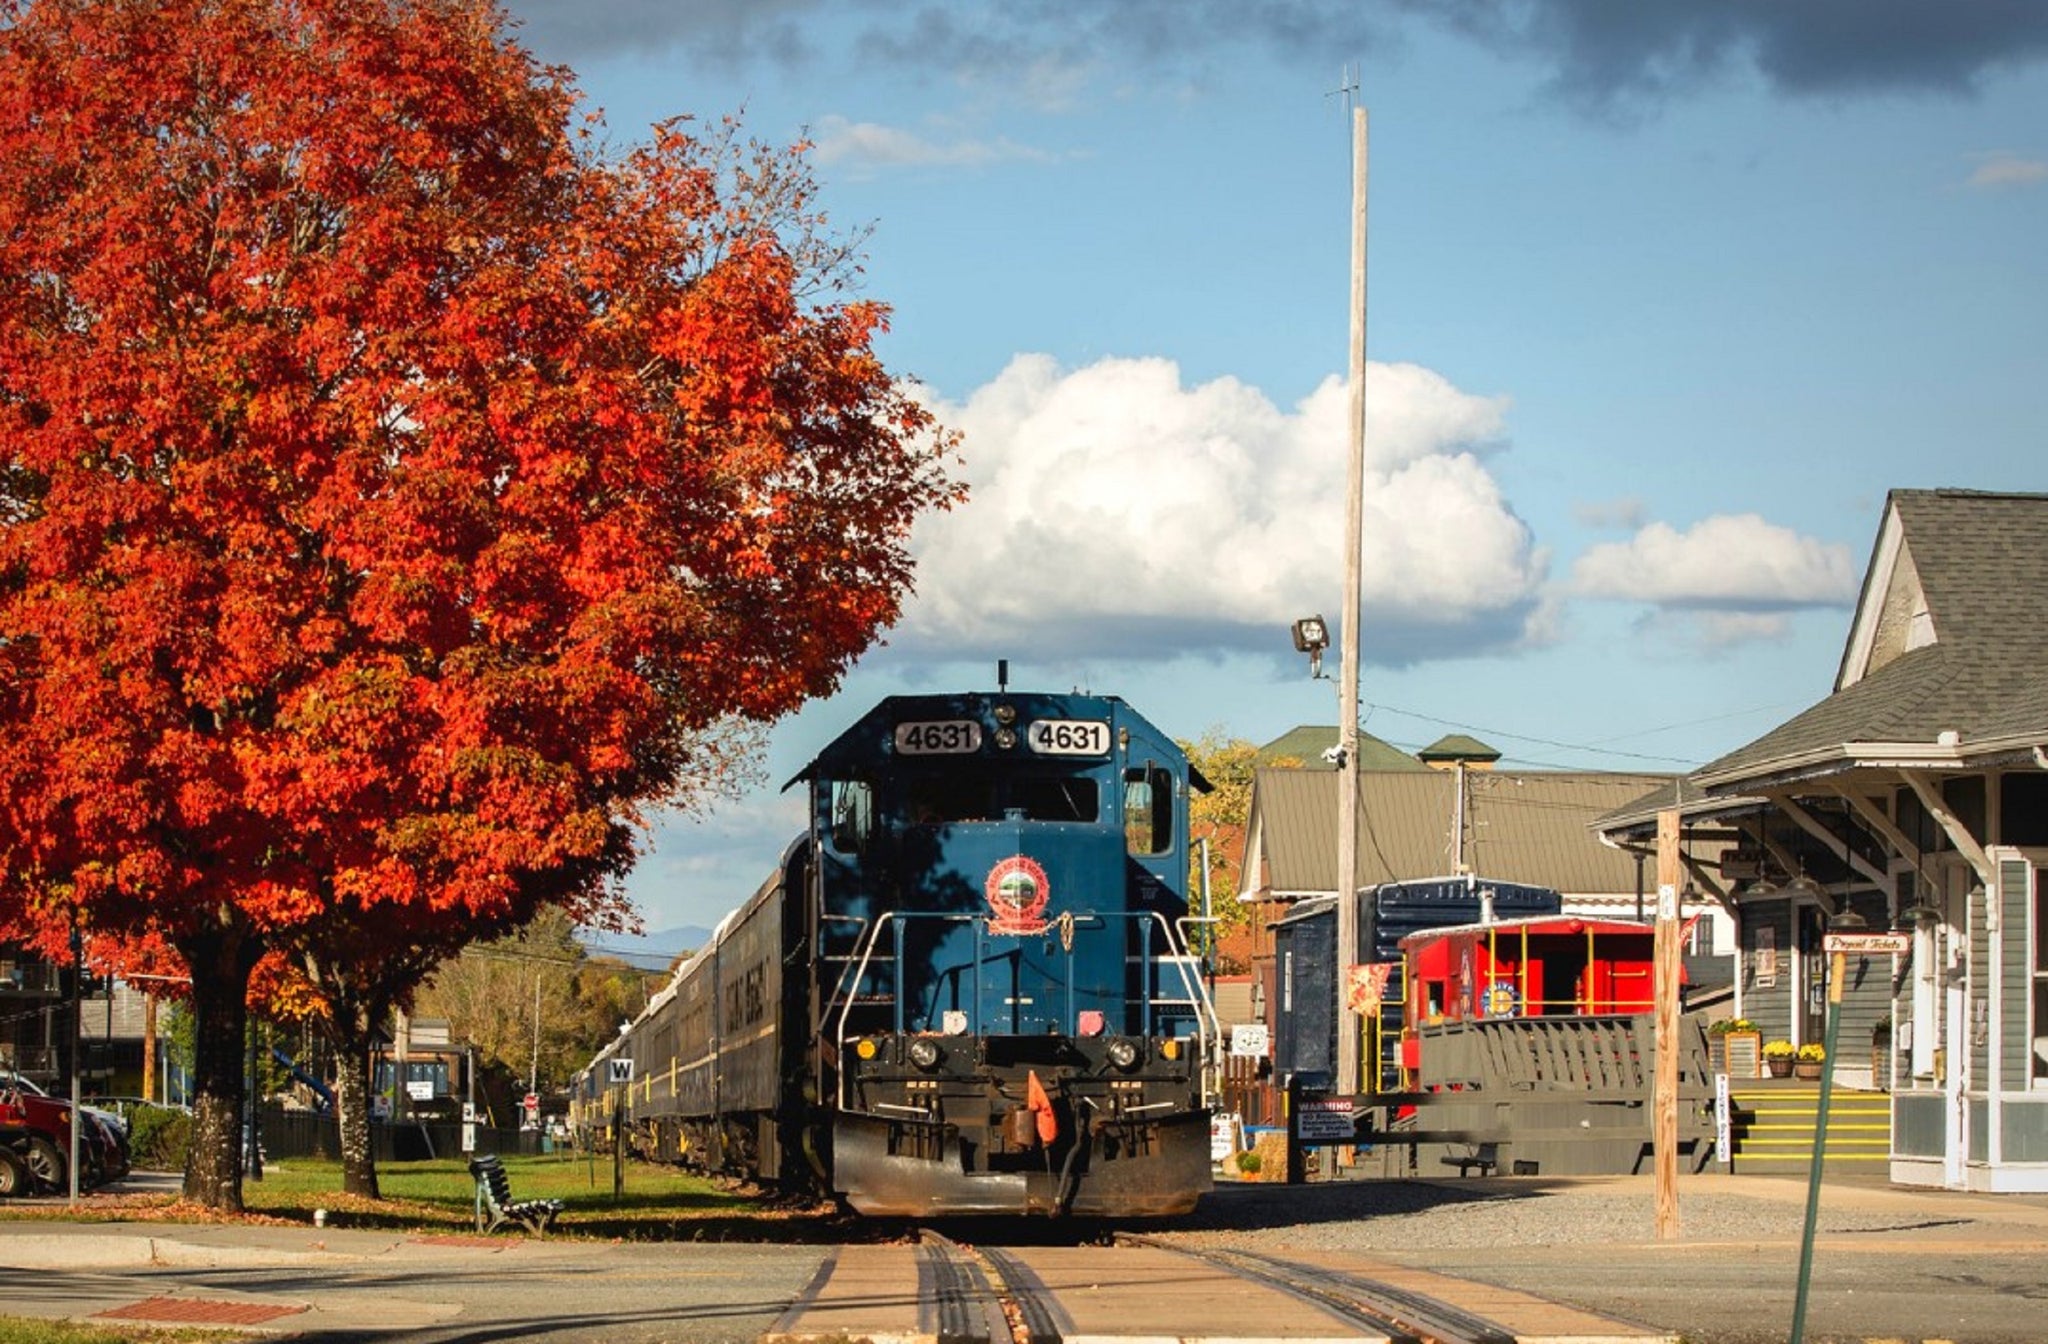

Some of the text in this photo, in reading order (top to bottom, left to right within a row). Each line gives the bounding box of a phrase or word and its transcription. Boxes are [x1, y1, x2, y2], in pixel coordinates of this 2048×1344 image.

[905, 724, 971, 749] 4631
[1038, 725, 1100, 749] 4631
[612, 1062, 631, 1078] W
[1298, 1101, 1353, 1111] WARNING
